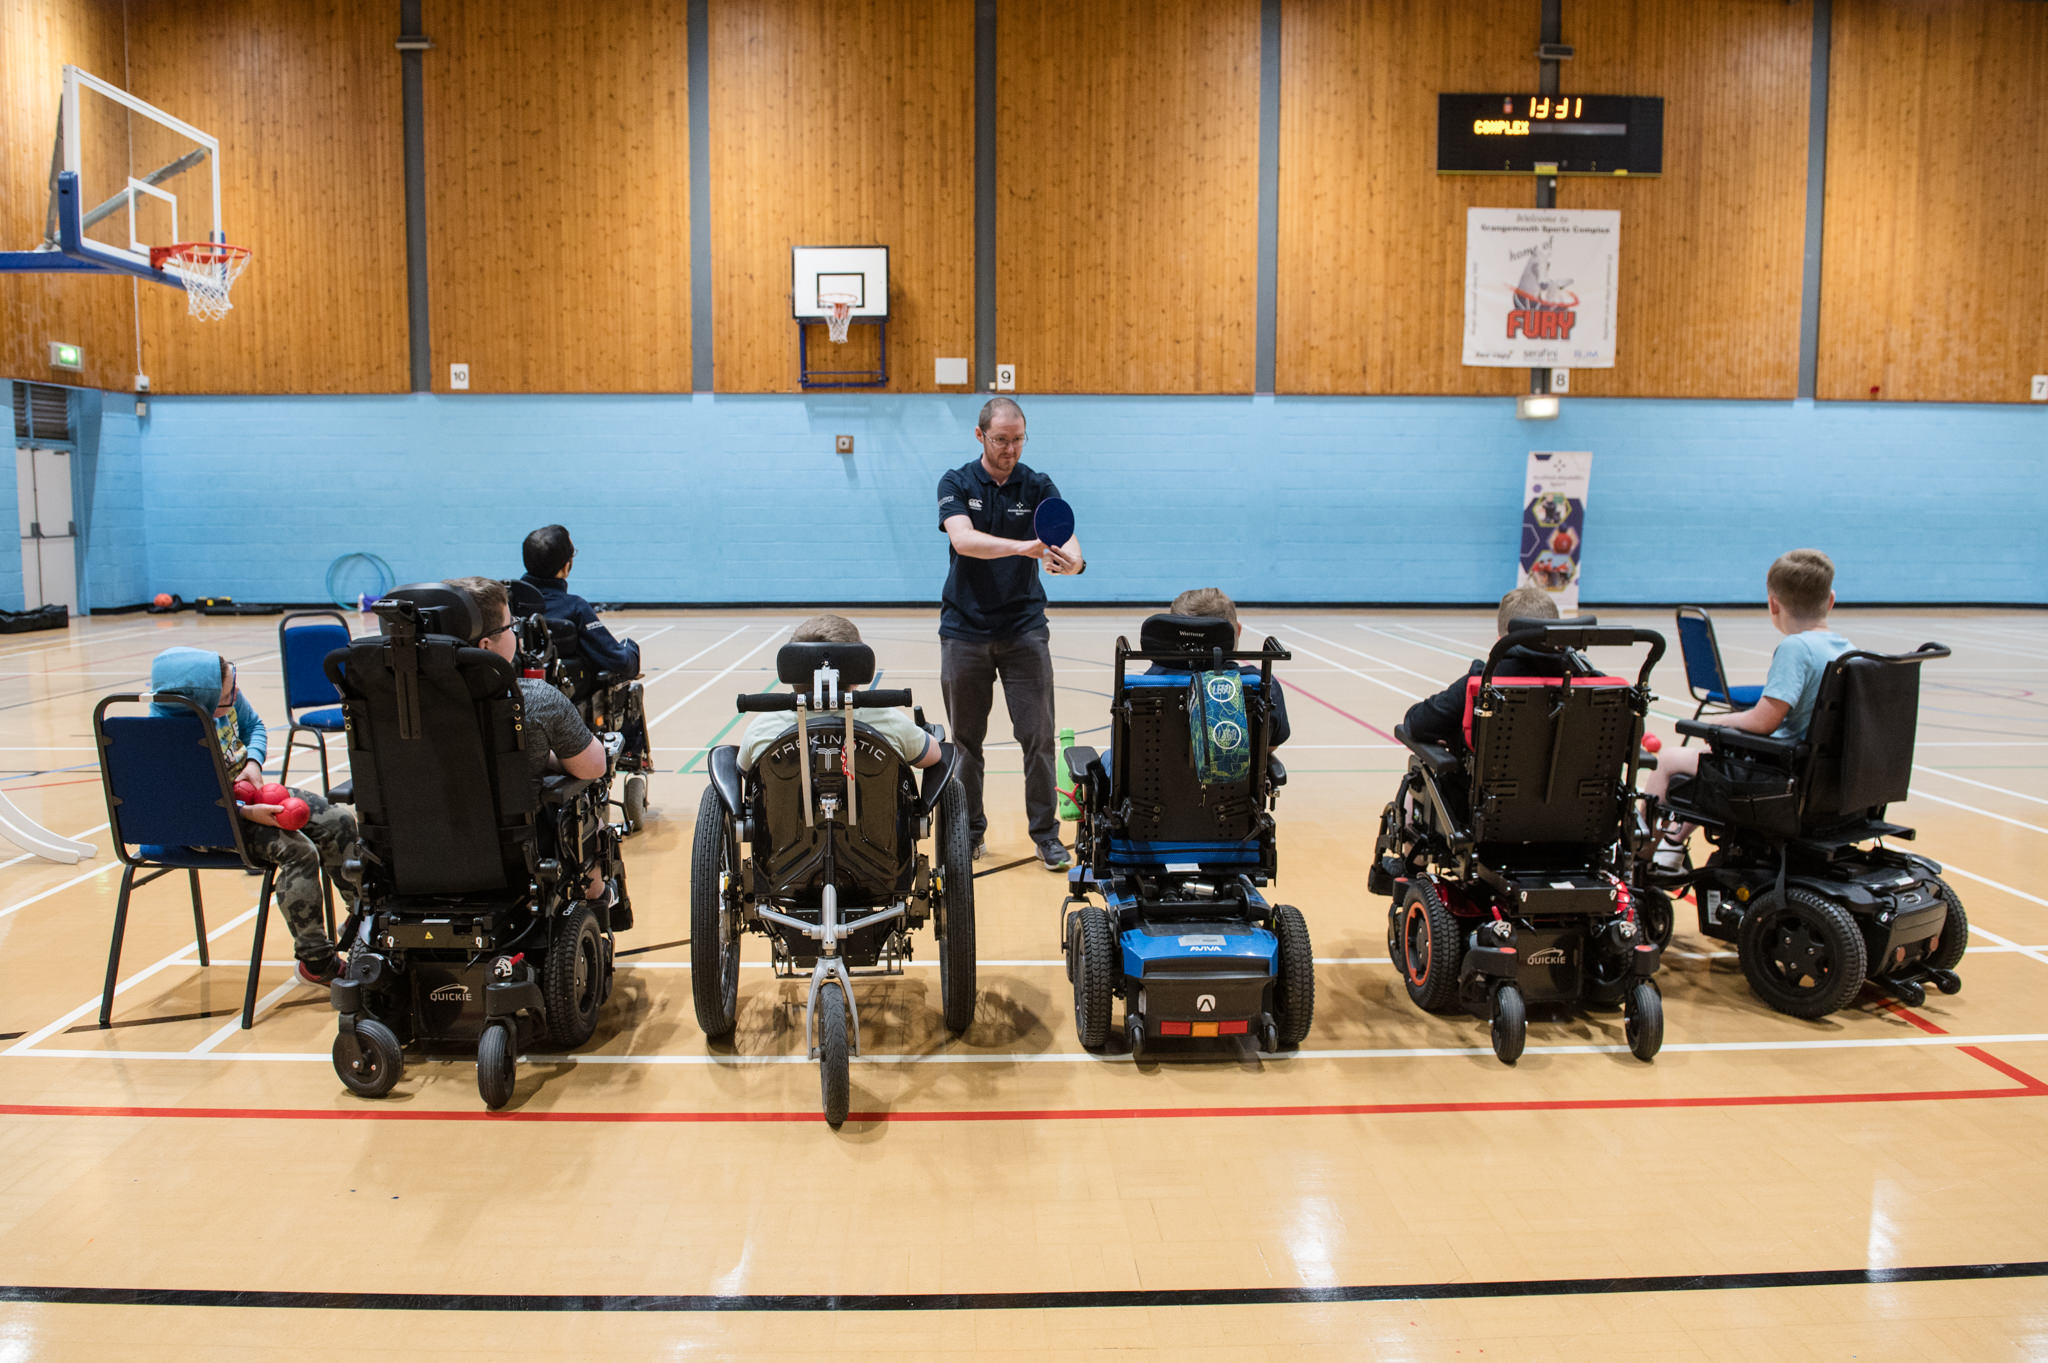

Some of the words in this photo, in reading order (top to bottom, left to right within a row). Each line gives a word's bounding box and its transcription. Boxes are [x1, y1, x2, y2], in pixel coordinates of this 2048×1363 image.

[1473, 119, 1530, 135] COMPLEX
[1506, 310, 1576, 339] FURY
[453, 370, 467, 382] 10
[1001, 370, 1011, 384] 9
[1556, 373, 1566, 387] 8
[2036, 381, 2046, 394] 7
[771, 734, 887, 762] TREKINTIC
[1527, 957, 1566, 965] QUICKIE
[430, 992, 472, 1001] QUICKIE
